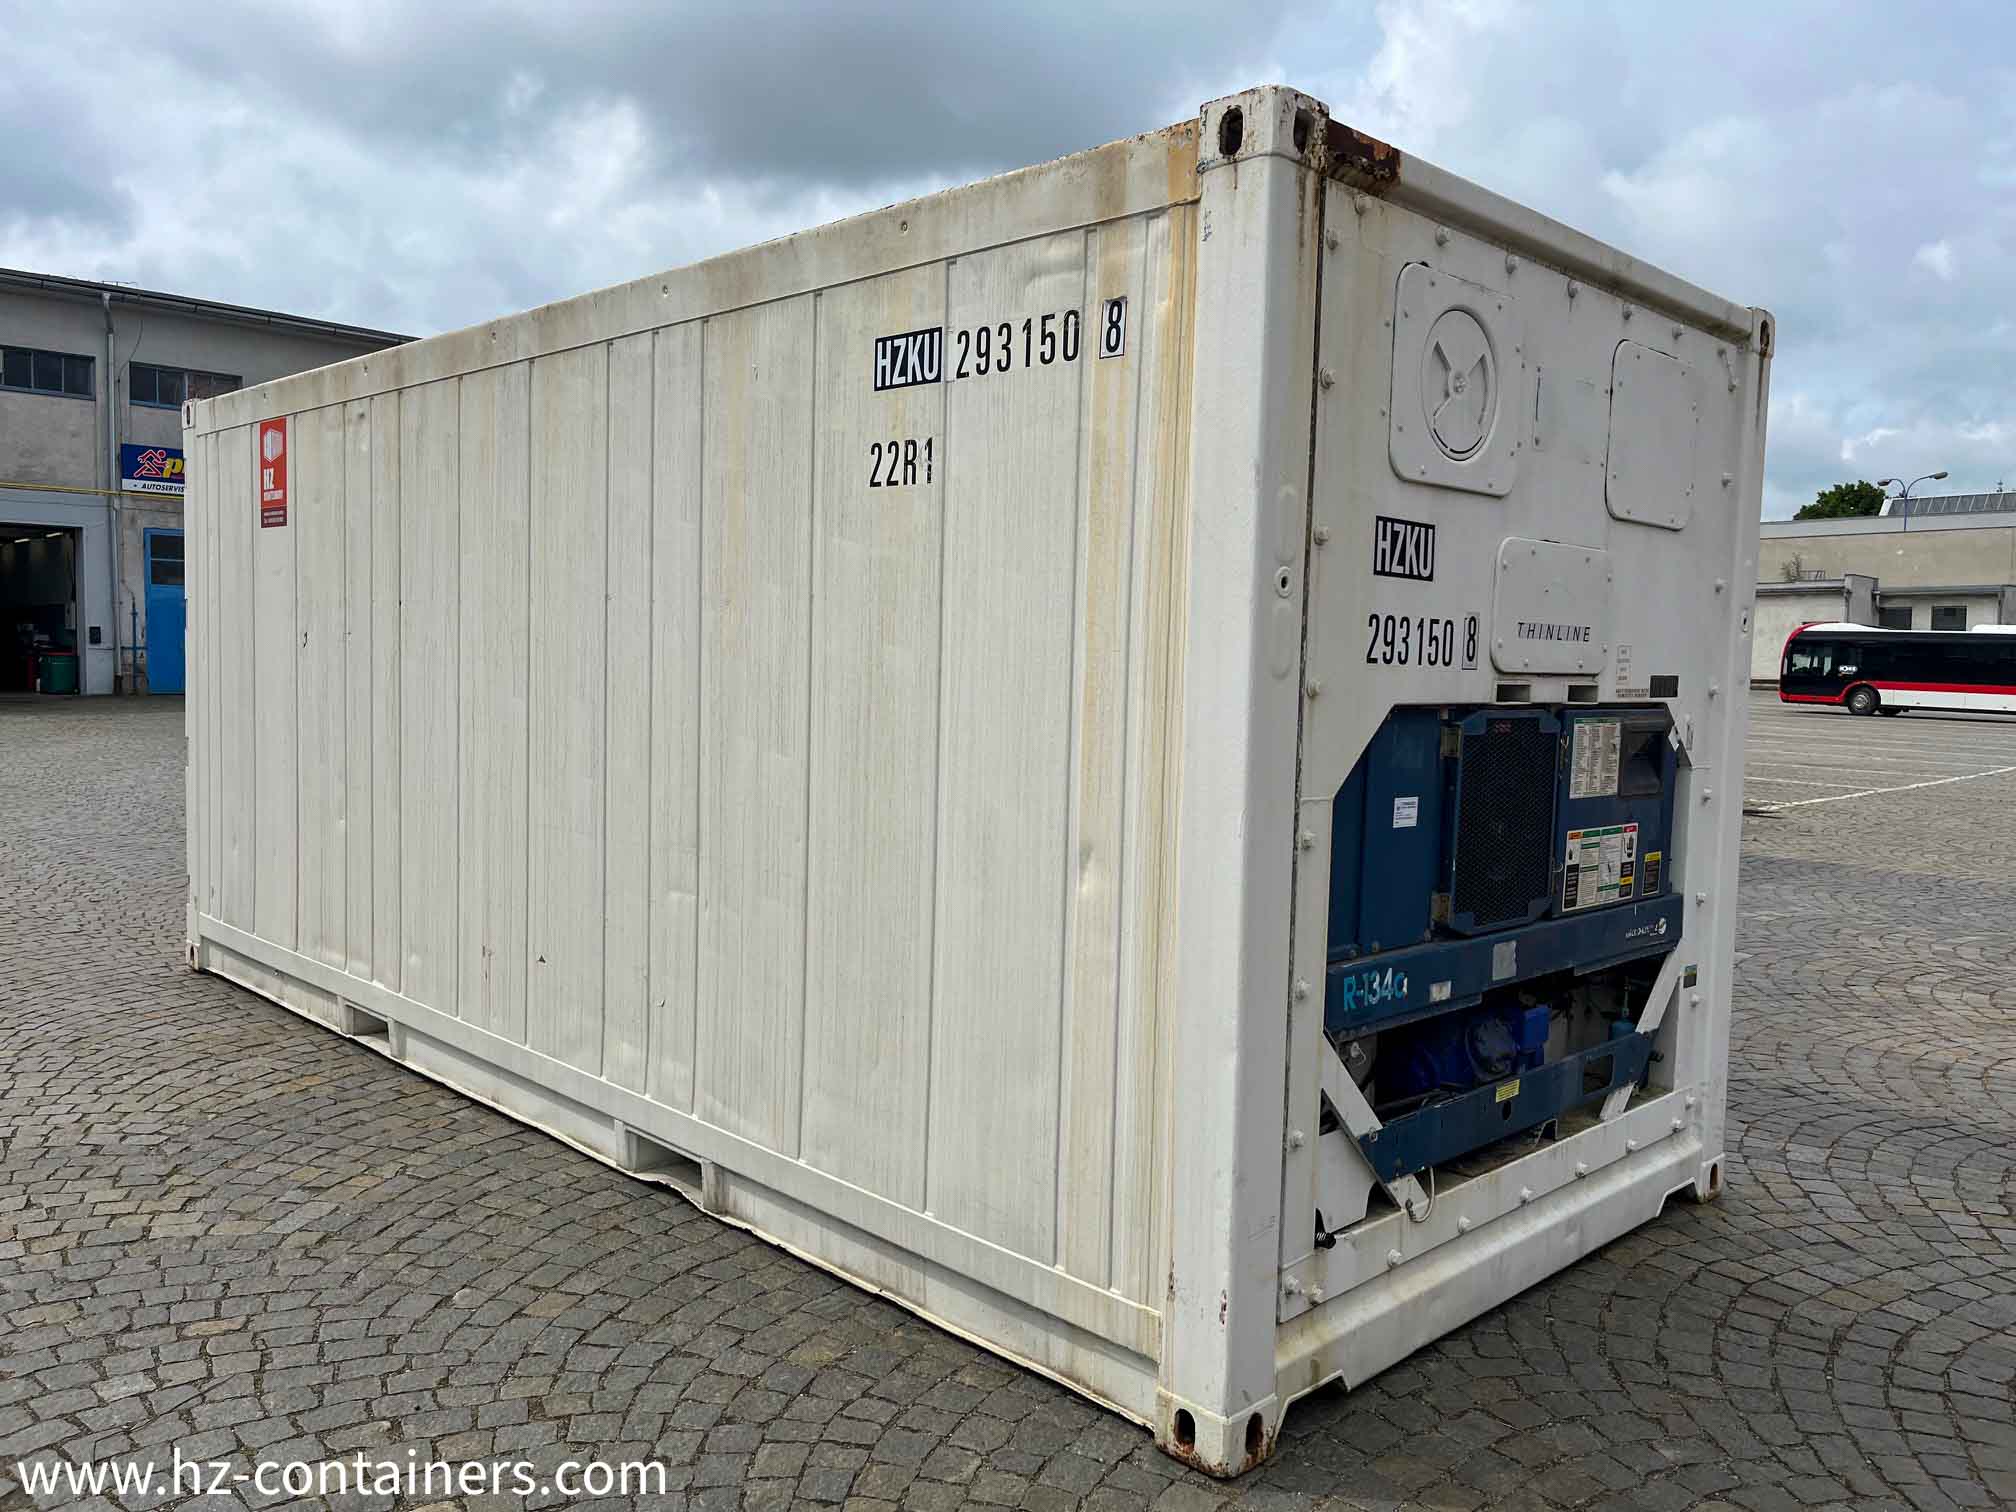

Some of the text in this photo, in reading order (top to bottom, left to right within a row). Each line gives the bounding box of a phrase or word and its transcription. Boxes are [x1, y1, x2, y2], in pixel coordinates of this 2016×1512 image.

[876, 300, 1123, 388] HZKU 293150 8
[869, 437, 933, 488] 22R1
[1376, 519, 1434, 578] HZKU
[1366, 613, 1477, 667] 293150 8
[1517, 621, 1591, 643] THINLINE
